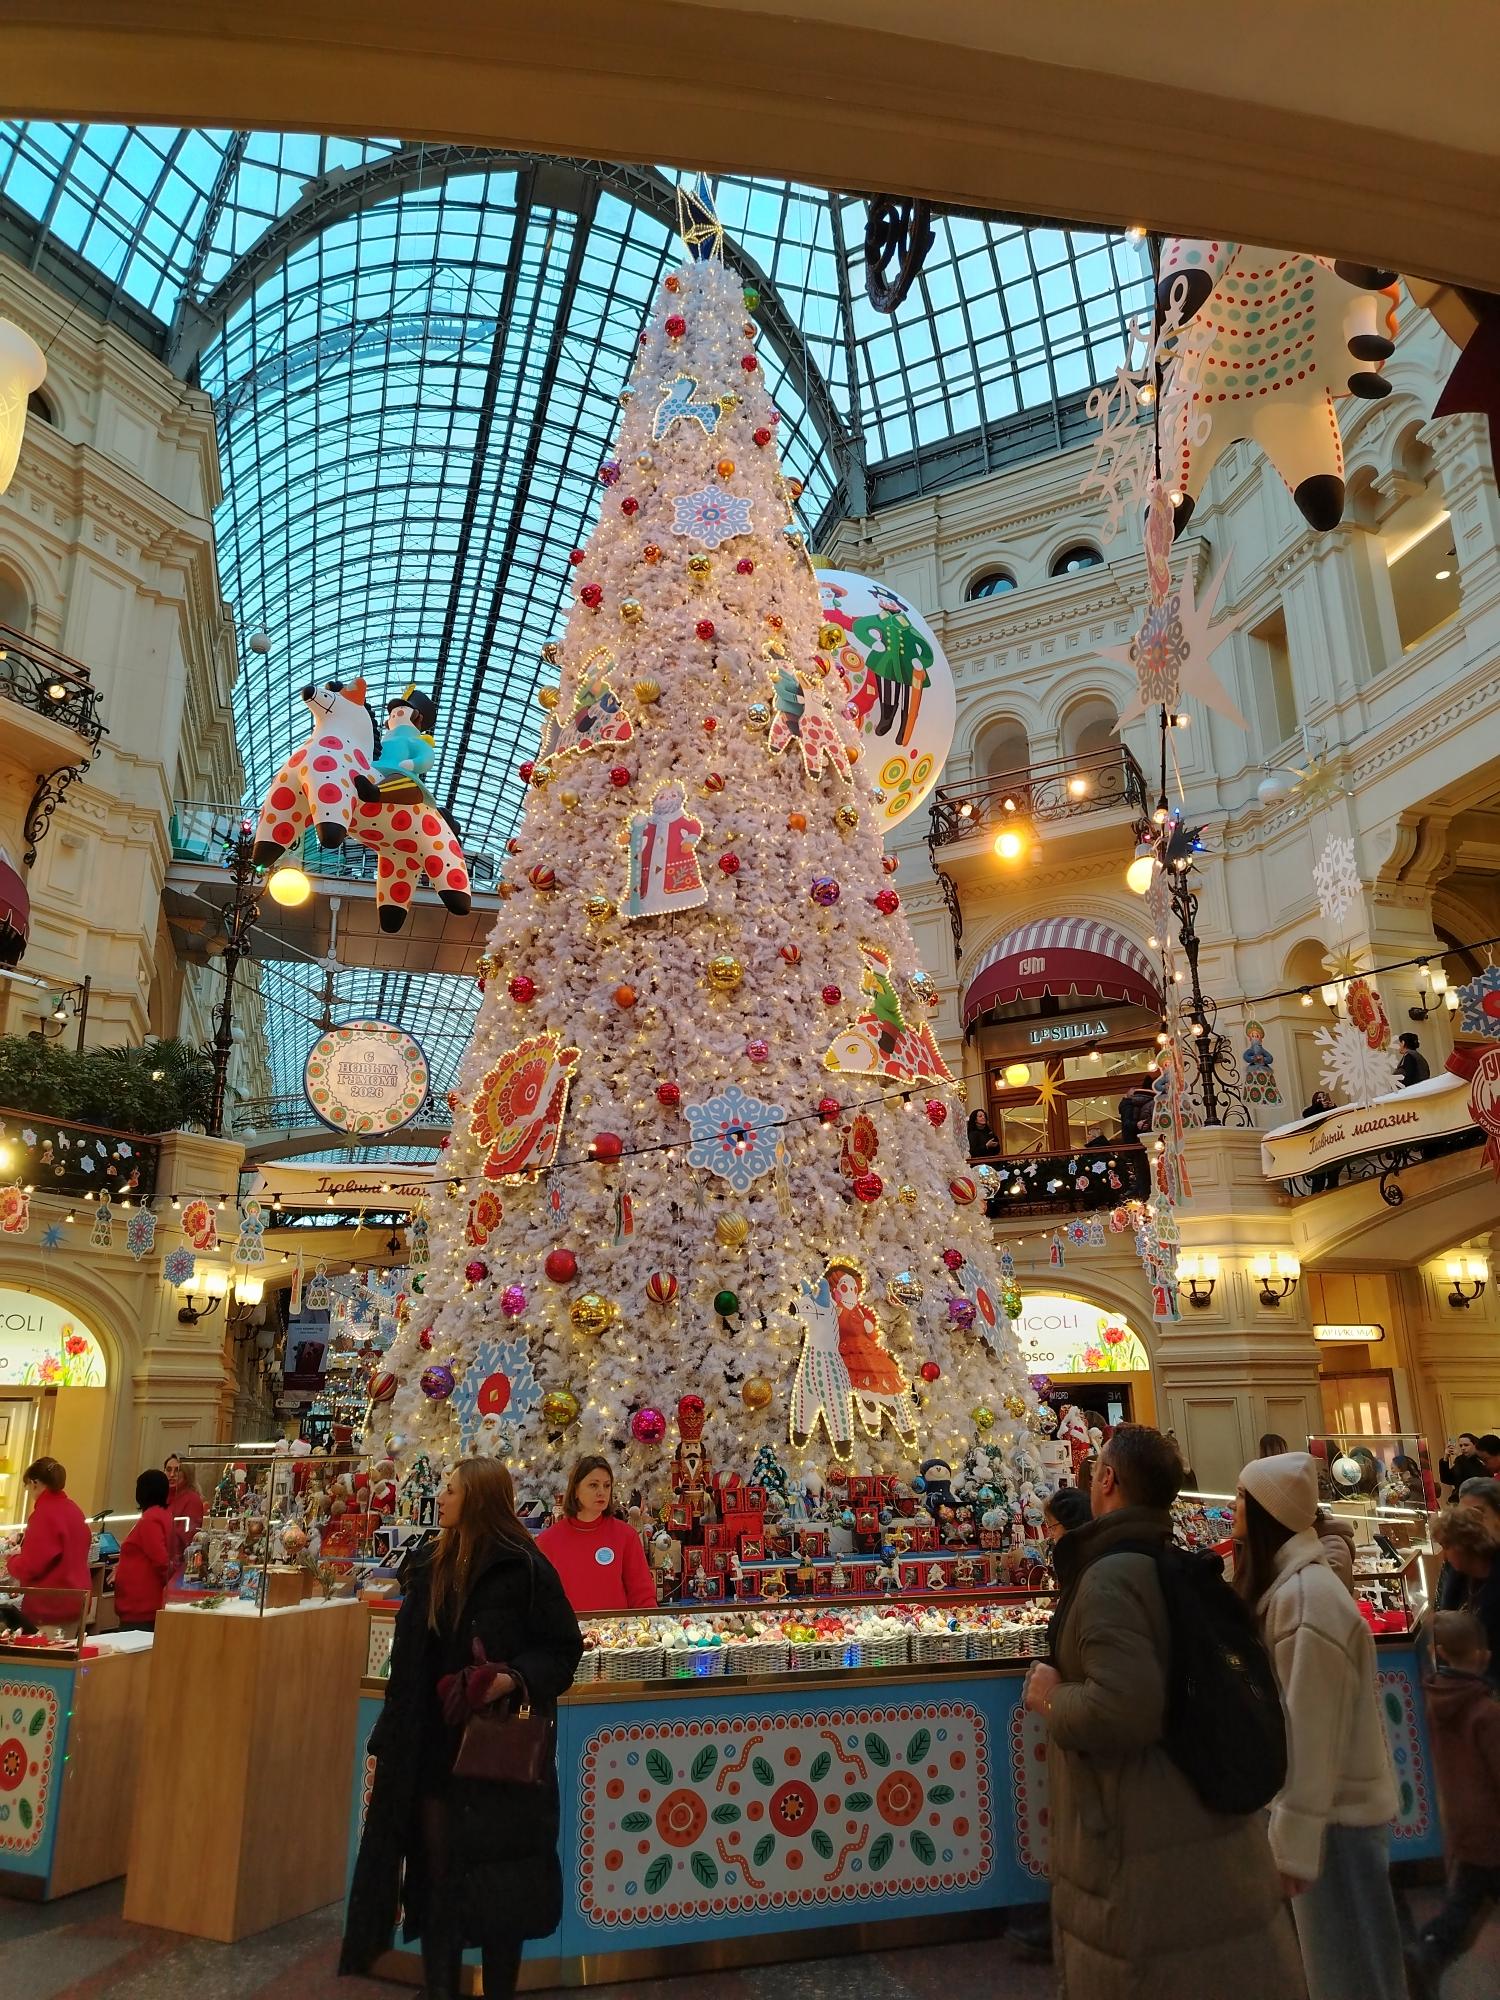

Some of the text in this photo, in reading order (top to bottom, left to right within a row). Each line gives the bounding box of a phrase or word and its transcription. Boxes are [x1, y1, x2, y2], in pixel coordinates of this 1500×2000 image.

[1050, 1021, 1107, 1040] SILLA
[339, 1062, 398, 1075] НОВЫМ
[351, 1086, 385, 1098] 2026
[1309, 1111, 1419, 1155] Главный магазин
[0, 1314, 43, 1332] OLI
[1024, 1353, 1055, 1361] OSCO
